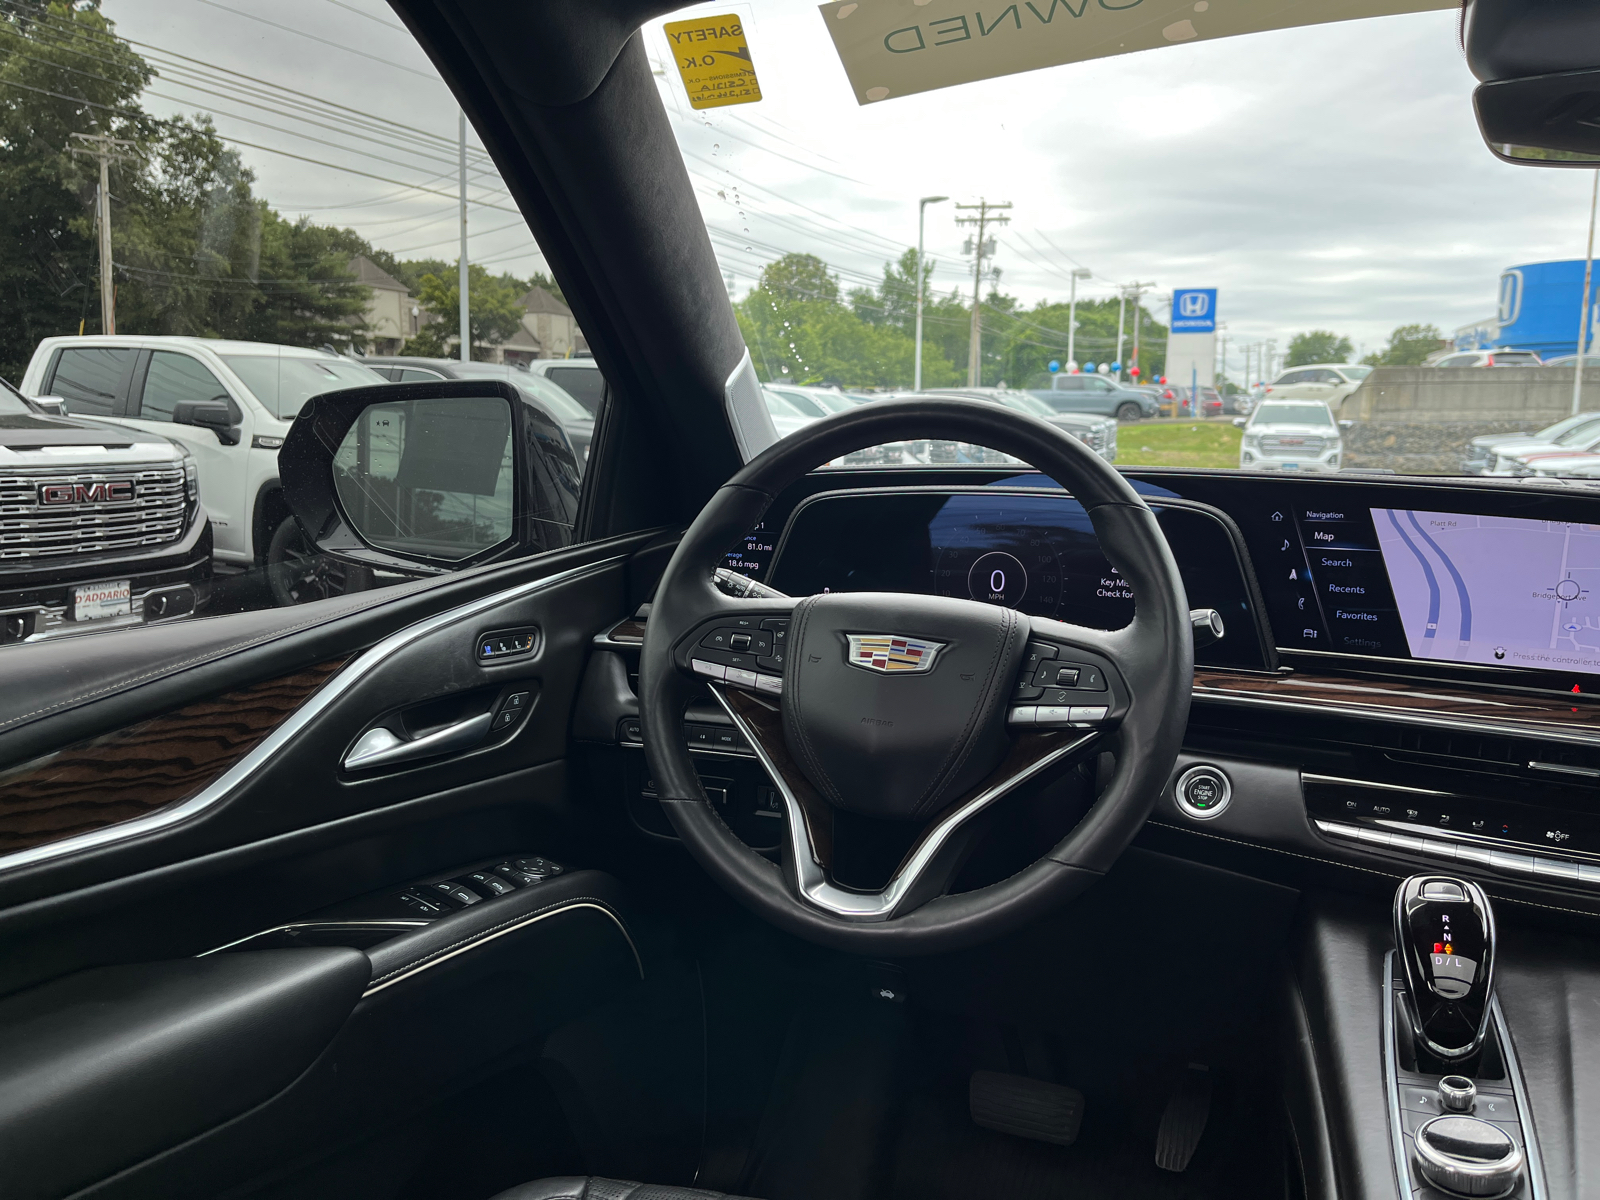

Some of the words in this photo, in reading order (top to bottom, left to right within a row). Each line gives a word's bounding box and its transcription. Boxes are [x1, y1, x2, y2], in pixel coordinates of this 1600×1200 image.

[42, 482, 132, 504] GMC
[1306, 511, 1344, 519] Navigation
[1314, 532, 1334, 542] Map
[744, 562, 759, 570] mpg
[1322, 558, 1352, 567] Search
[990, 570, 1005, 592] 0
[1101, 578, 1114, 588] Key
[1097, 589, 1120, 597] Check
[1122, 590, 1133, 598] for
[1329, 584, 1365, 594] Recents
[76, 589, 130, 604] D'ADDARIO
[1336, 610, 1377, 621] Favorites
[1344, 637, 1381, 648] Settings
[1513, 652, 1534, 660] Press
[1537, 653, 1550, 662] the
[860, 717, 894, 727] AIRBAG
